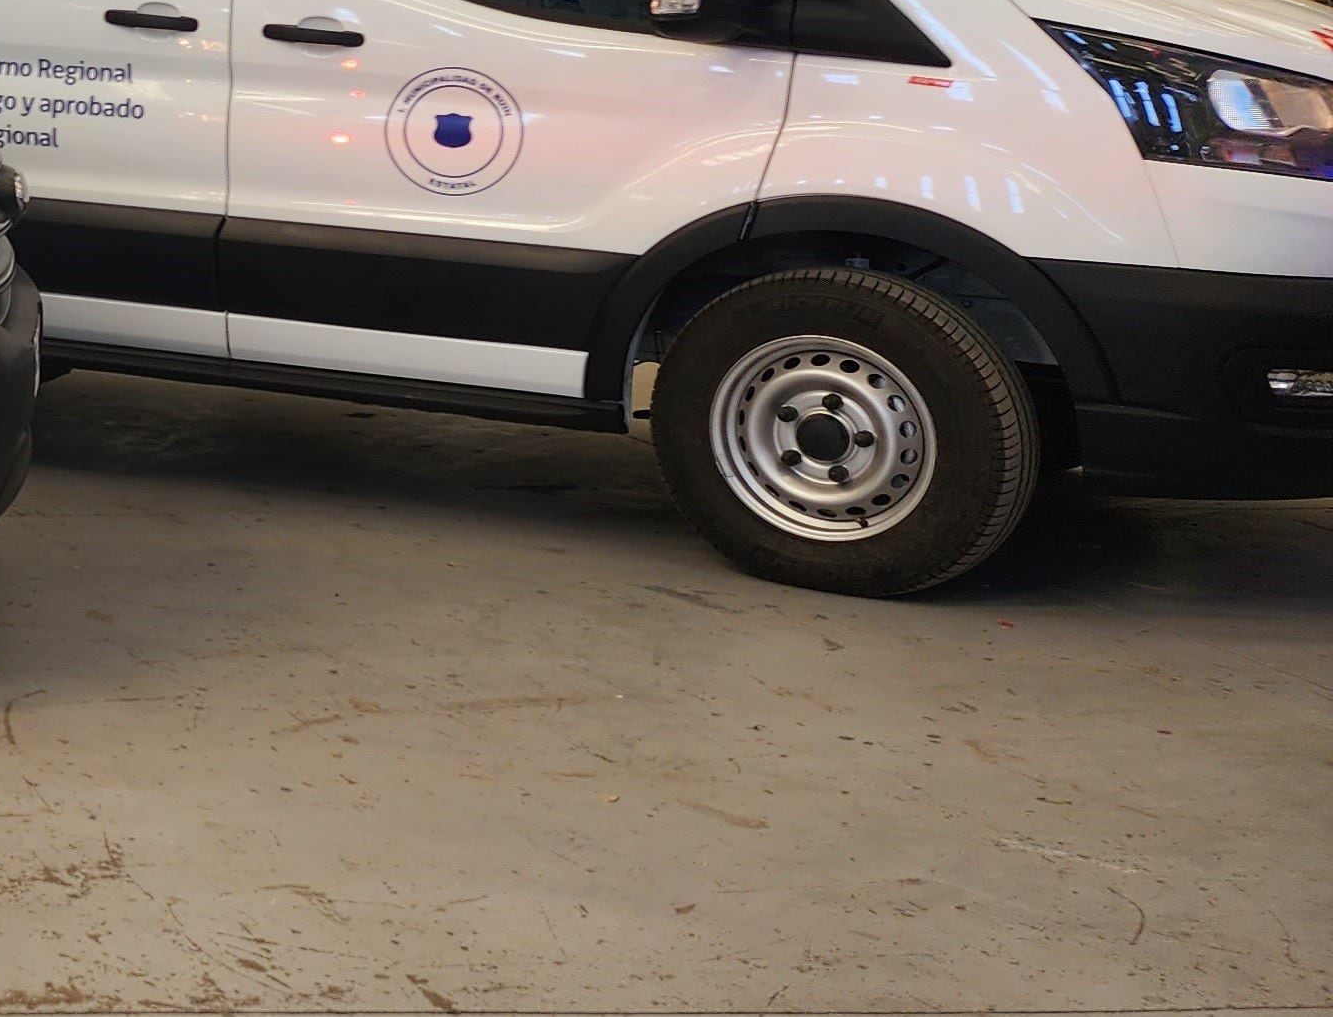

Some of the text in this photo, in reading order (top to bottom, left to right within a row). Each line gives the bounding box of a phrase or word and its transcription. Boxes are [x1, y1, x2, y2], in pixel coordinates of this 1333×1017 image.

[38, 59, 133, 85] Regional
[21, 96, 36, 116] y
[40, 96, 144, 120] aprobado
